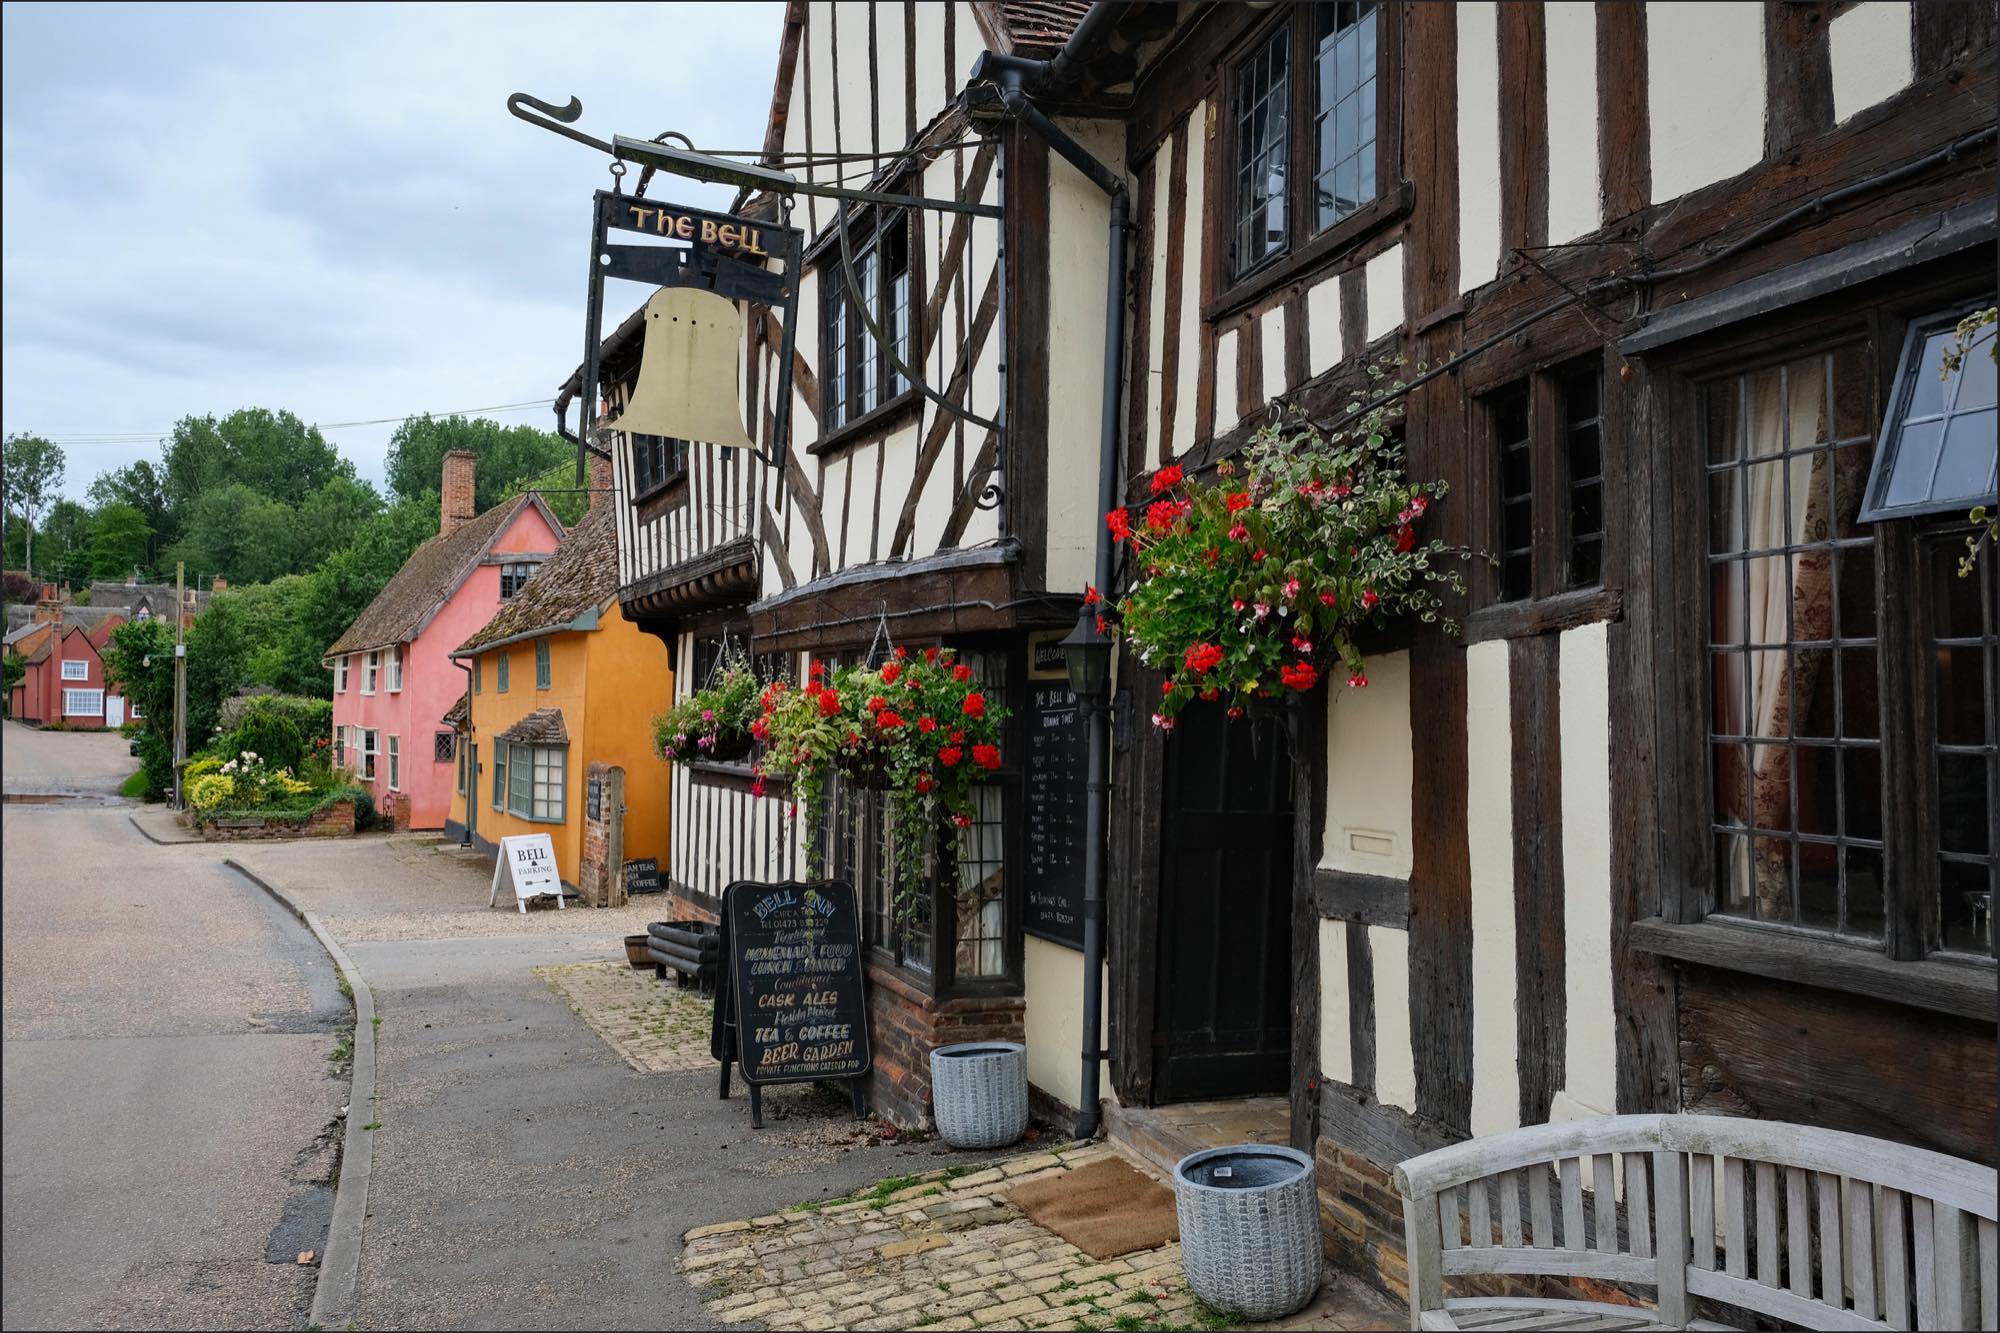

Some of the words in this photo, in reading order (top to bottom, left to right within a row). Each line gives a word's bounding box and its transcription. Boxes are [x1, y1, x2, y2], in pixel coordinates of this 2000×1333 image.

[1049, 690, 1062, 707] BELL
[517, 848, 548, 861] BELL
[518, 866, 552, 875] PARKING
[638, 863, 656, 871] TEAS
[632, 879, 657, 888] COFFEE
[752, 889, 797, 921] BELL
[819, 943, 854, 958] FOOD
[750, 960, 793, 975] LUNCH
[758, 993, 796, 1008] CASK
[803, 991, 839, 1006] ALES
[754, 1027, 779, 1043] TEA
[784, 1028, 795, 1041] &
[798, 1024, 852, 1040] COFFEE
[760, 1042, 799, 1065] BEER
[803, 1040, 855, 1061] GARDEN
[756, 1065, 780, 1075] PRIVATE
[784, 1062, 819, 1073] FUNCTIONS
[820, 1061, 846, 1071] CATERED
